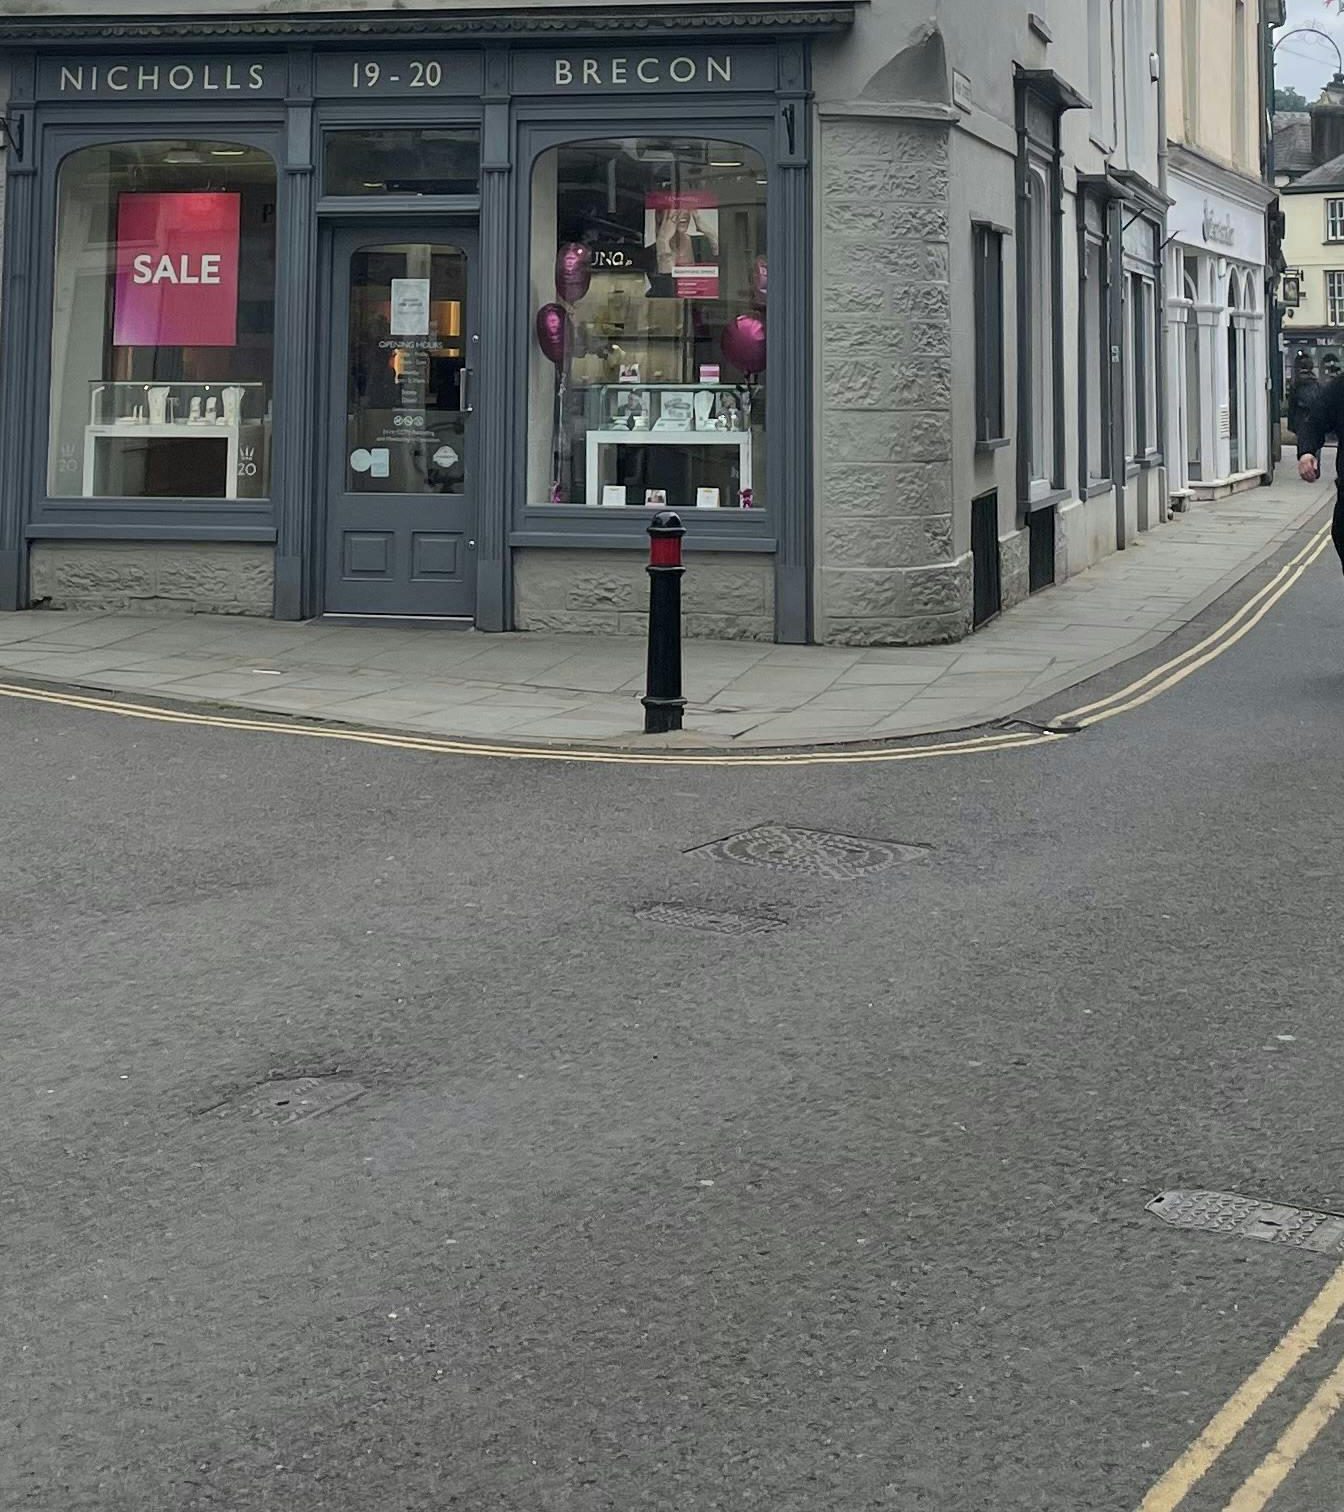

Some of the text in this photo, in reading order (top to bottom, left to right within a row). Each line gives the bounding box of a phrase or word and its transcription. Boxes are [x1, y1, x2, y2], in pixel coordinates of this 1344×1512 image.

[60, 64, 264, 91] NICHOLLS
[555, 55, 731, 85] BRECON
[133, 254, 221, 285] SALE
